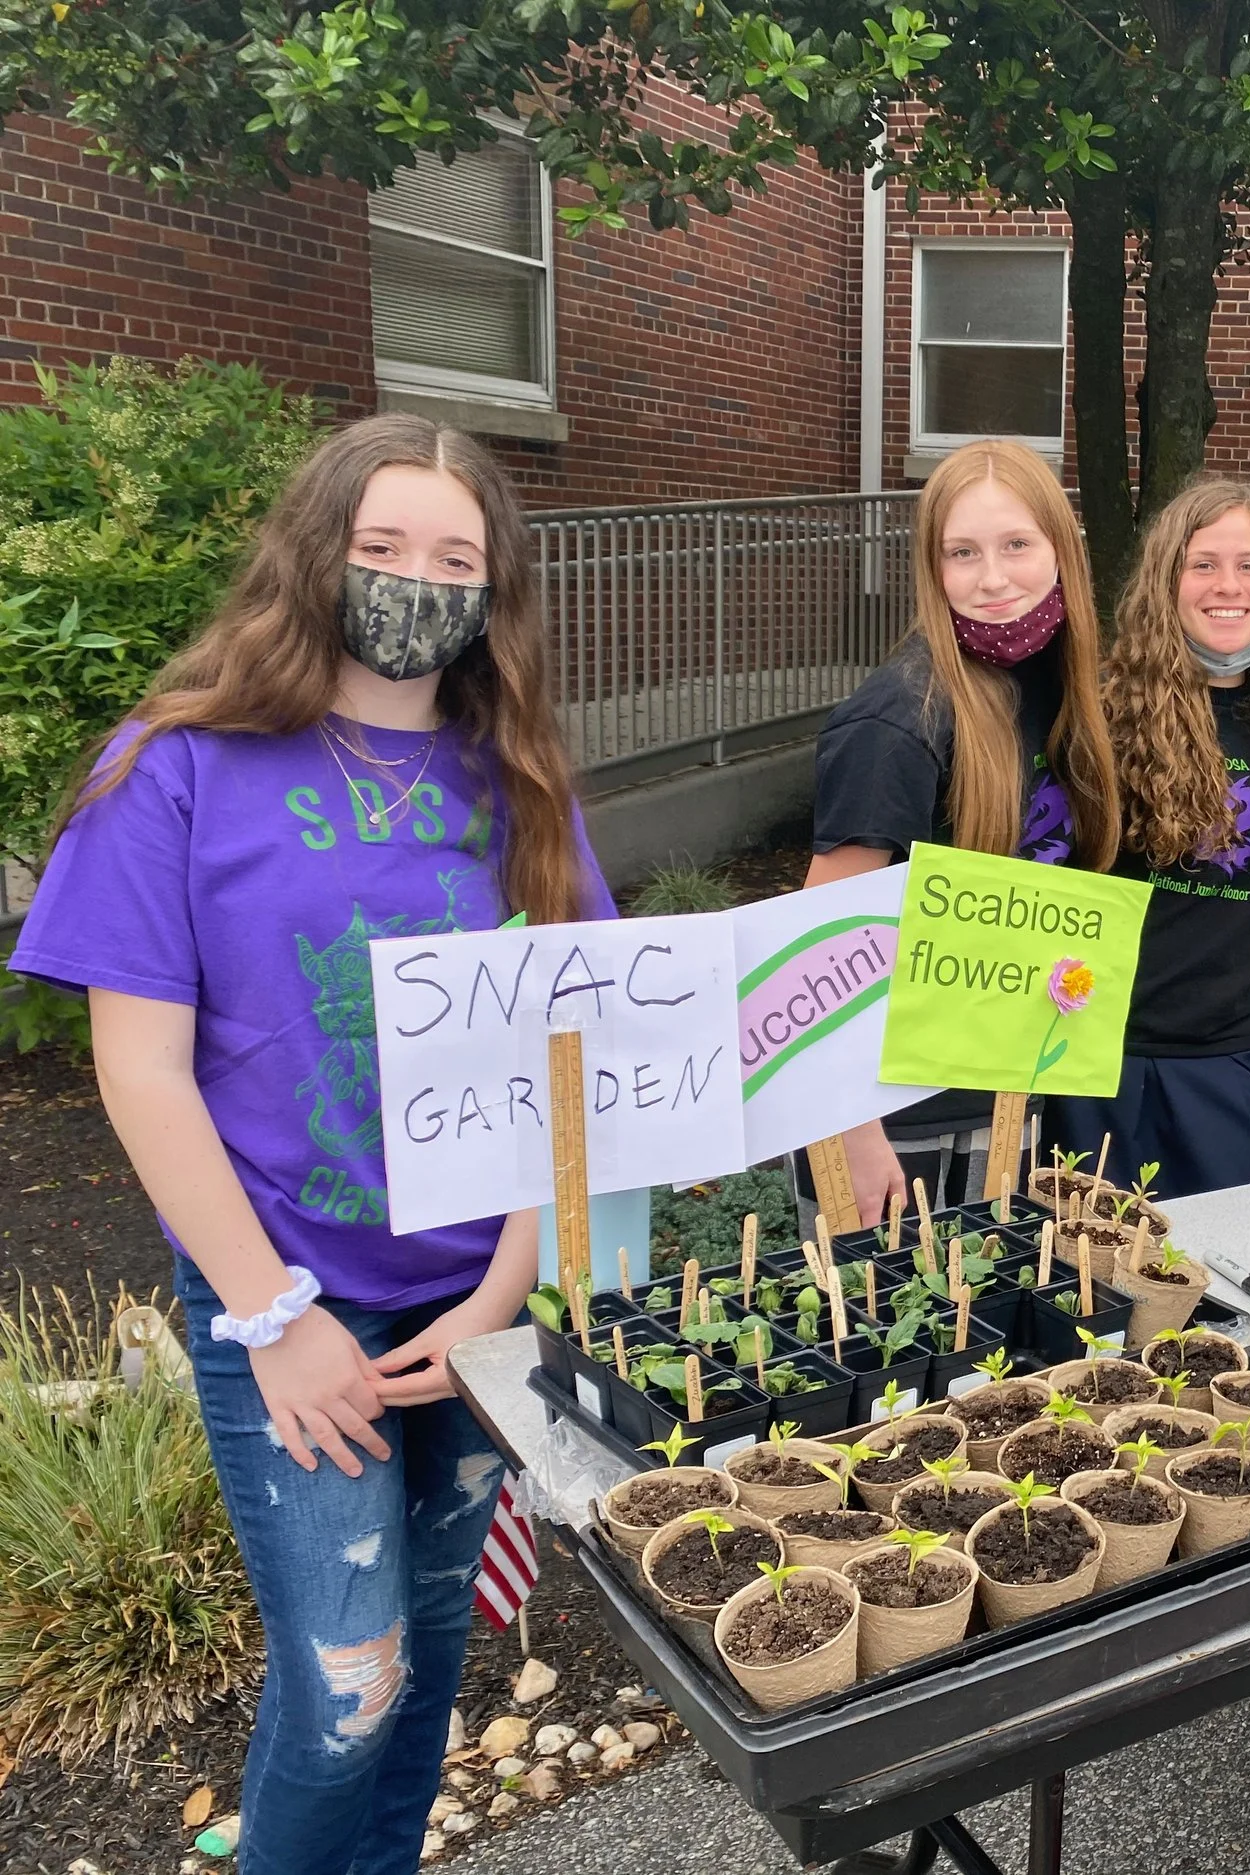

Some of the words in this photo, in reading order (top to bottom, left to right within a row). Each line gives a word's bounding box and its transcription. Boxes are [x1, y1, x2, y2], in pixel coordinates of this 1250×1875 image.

[1225, 758, 1249, 771] DSA
[919, 874, 1103, 941] Scabiosa
[1148, 870, 1191, 894] National
[1220, 884, 1250, 901] Honor
[394, 941, 697, 1038] SNAC
[909, 939, 1041, 995] flower
[740, 928, 888, 1066] ucchini
[300, 1166, 388, 1226] Clas
[690, 1364, 701, 1405] Zucchini
